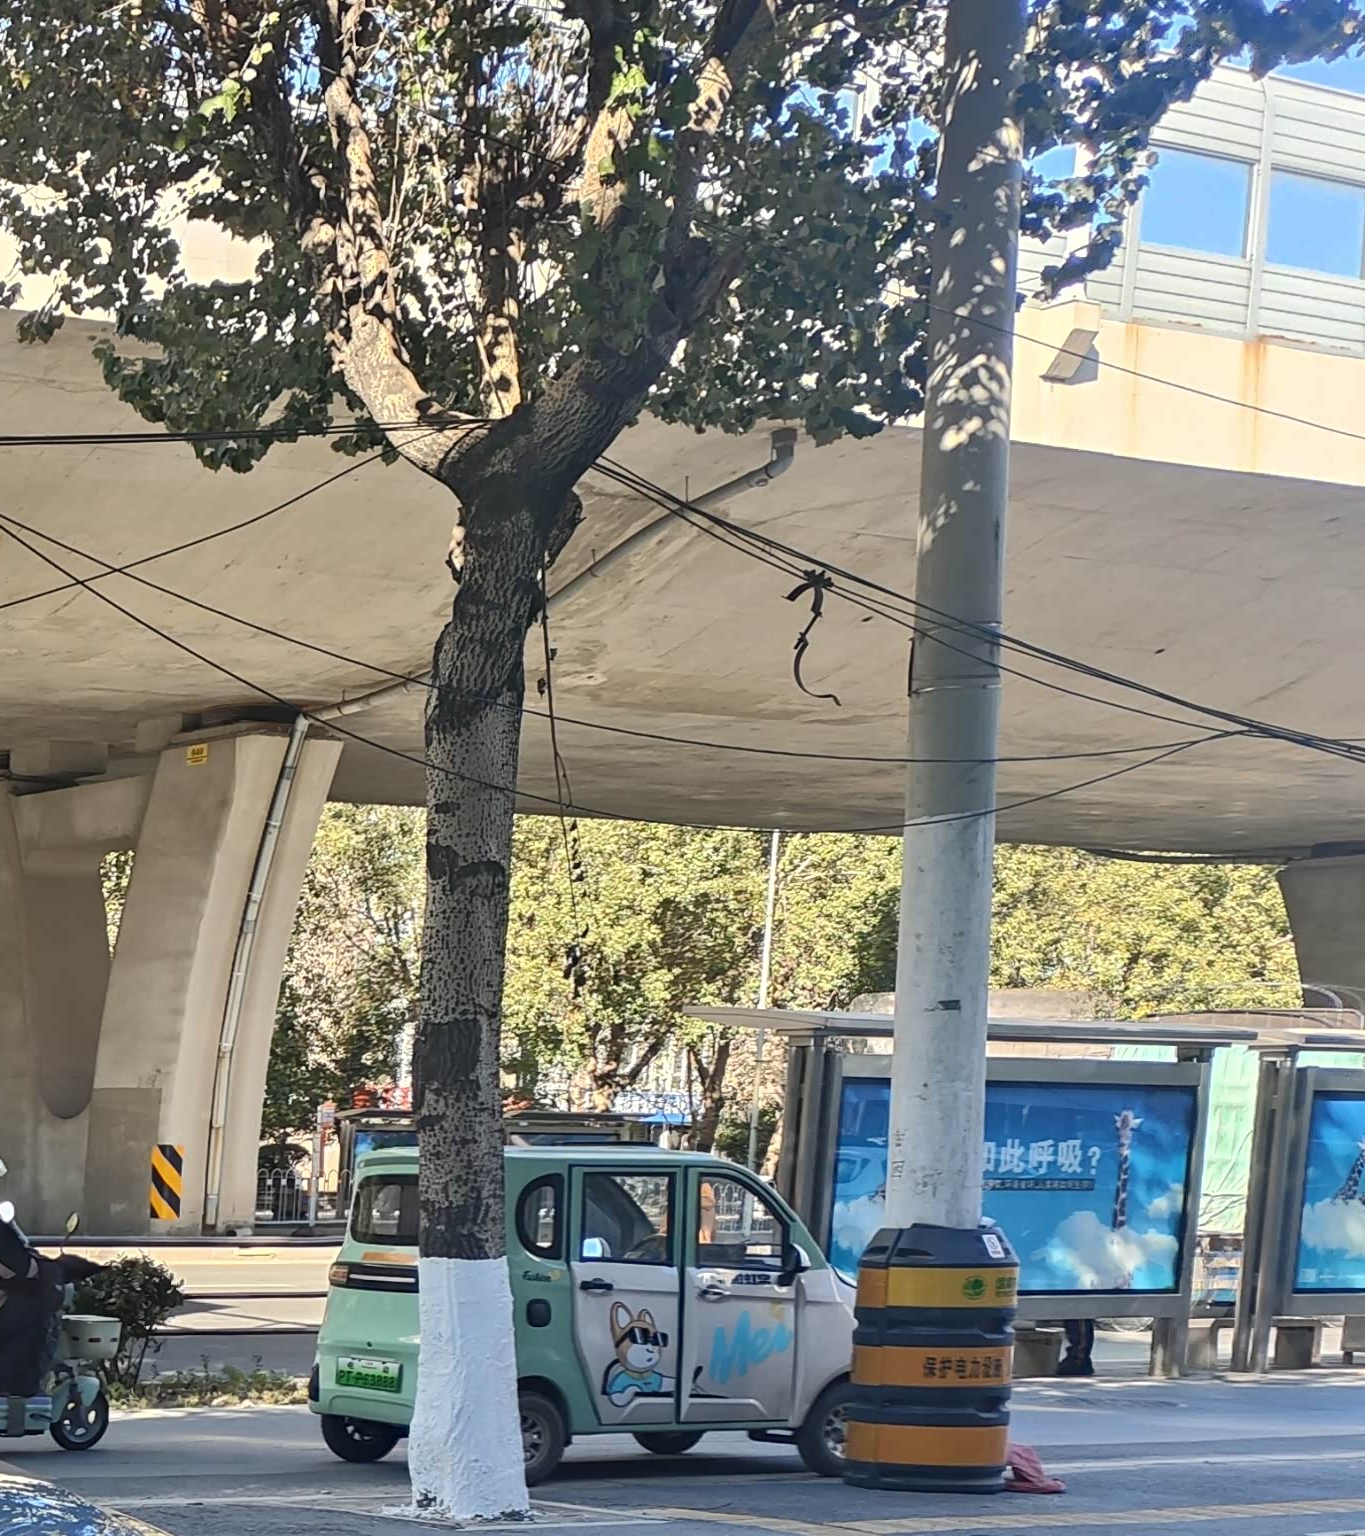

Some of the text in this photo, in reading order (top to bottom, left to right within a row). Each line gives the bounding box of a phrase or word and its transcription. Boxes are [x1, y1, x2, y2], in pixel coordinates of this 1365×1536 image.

[923, 1355, 1003, 1379] 保护电力设施
